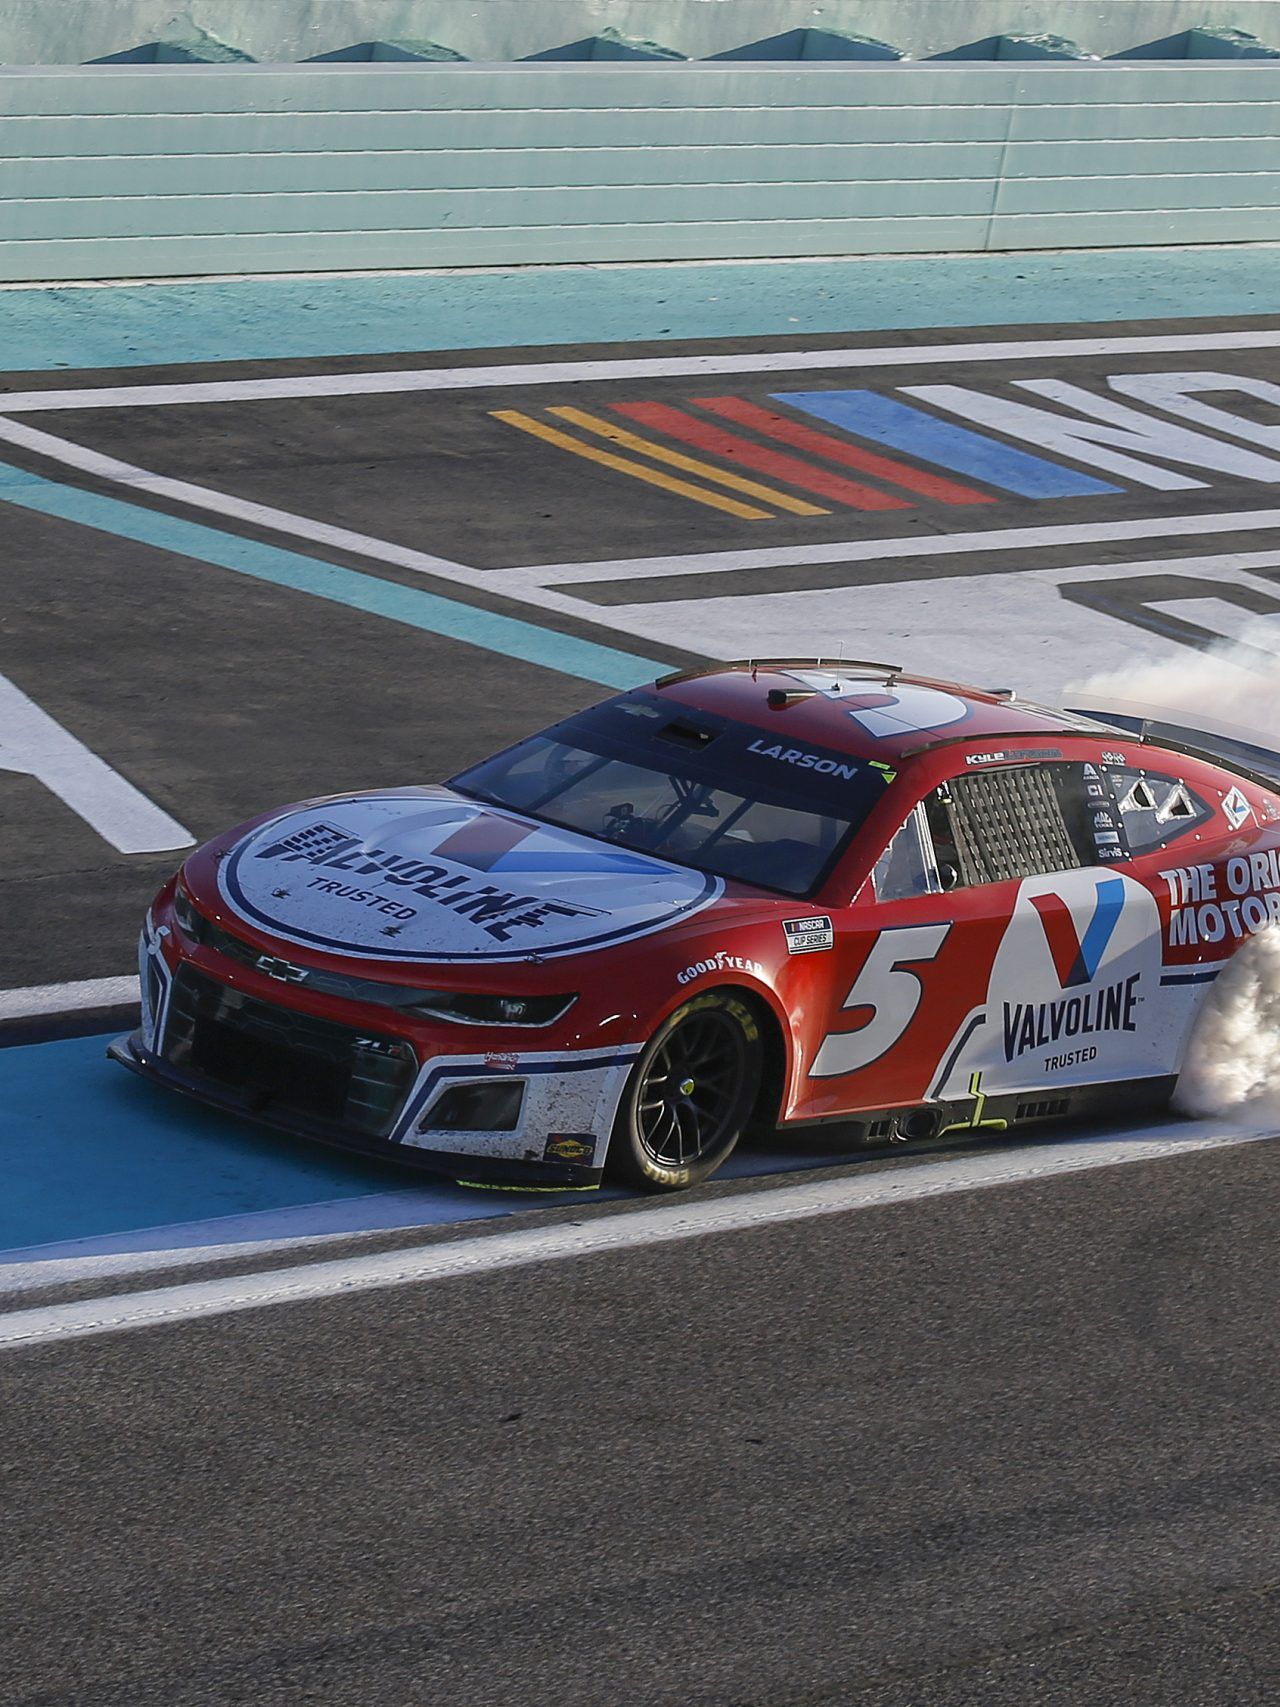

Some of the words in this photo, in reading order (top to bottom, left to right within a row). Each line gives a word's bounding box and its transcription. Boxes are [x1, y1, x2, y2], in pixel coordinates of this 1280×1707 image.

[747, 739, 858, 780] LARSON
[254, 824, 603, 942] VALVOLINE
[306, 877, 418, 921] TRUSTED
[1157, 863, 1217, 906] THE
[793, 935, 806, 946] CUP
[806, 933, 827, 944] SERIES
[799, 919, 825, 931] NASCAR
[808, 921, 953, 1078] 5
[1003, 972, 1141, 1063] VALVOLINE
[1044, 1046, 1098, 1072] TRUSTED
[643, 1160, 690, 1185] EAGLE
